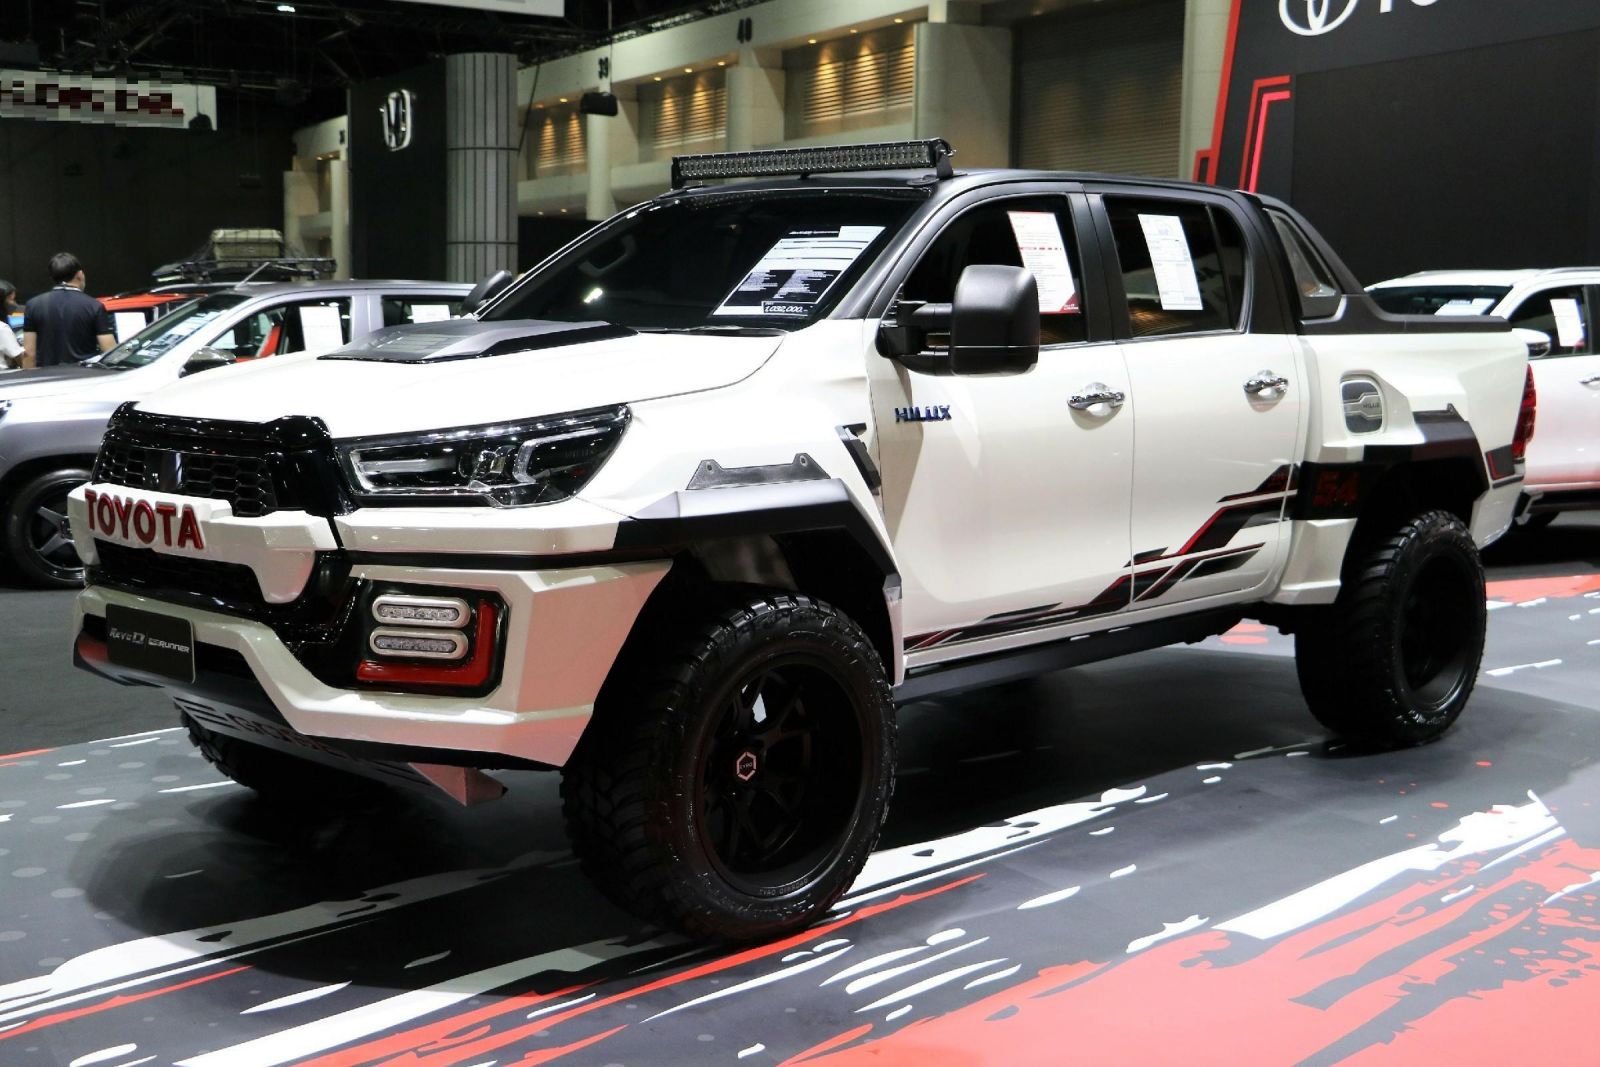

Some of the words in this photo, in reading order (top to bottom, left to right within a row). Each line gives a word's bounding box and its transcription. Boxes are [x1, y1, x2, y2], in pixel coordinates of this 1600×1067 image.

[737, 16, 753, 45] 40
[895, 404, 952, 423] HILUX
[84, 488, 205, 550] TOYOTA
